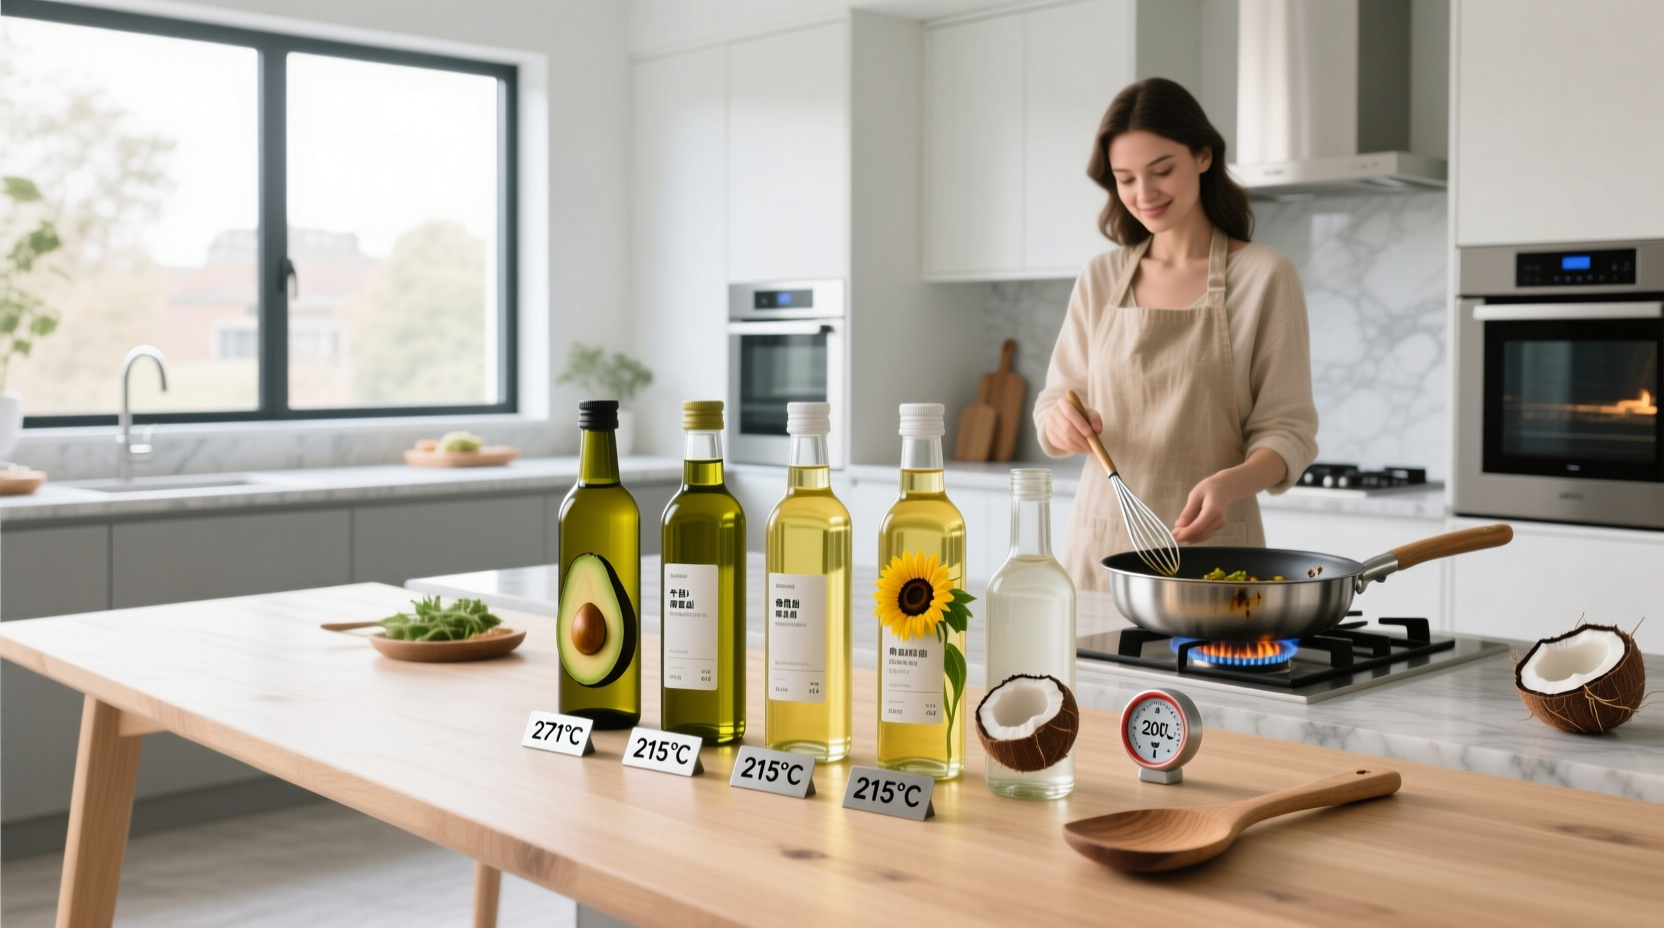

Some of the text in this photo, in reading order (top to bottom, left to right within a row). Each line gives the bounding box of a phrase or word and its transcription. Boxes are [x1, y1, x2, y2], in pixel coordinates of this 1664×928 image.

[531, 720, 584, 746] 271°C
[633, 737, 691, 765] 215°C
[740, 756, 804, 786] 215°C
[852, 776, 922, 808] 215°C
